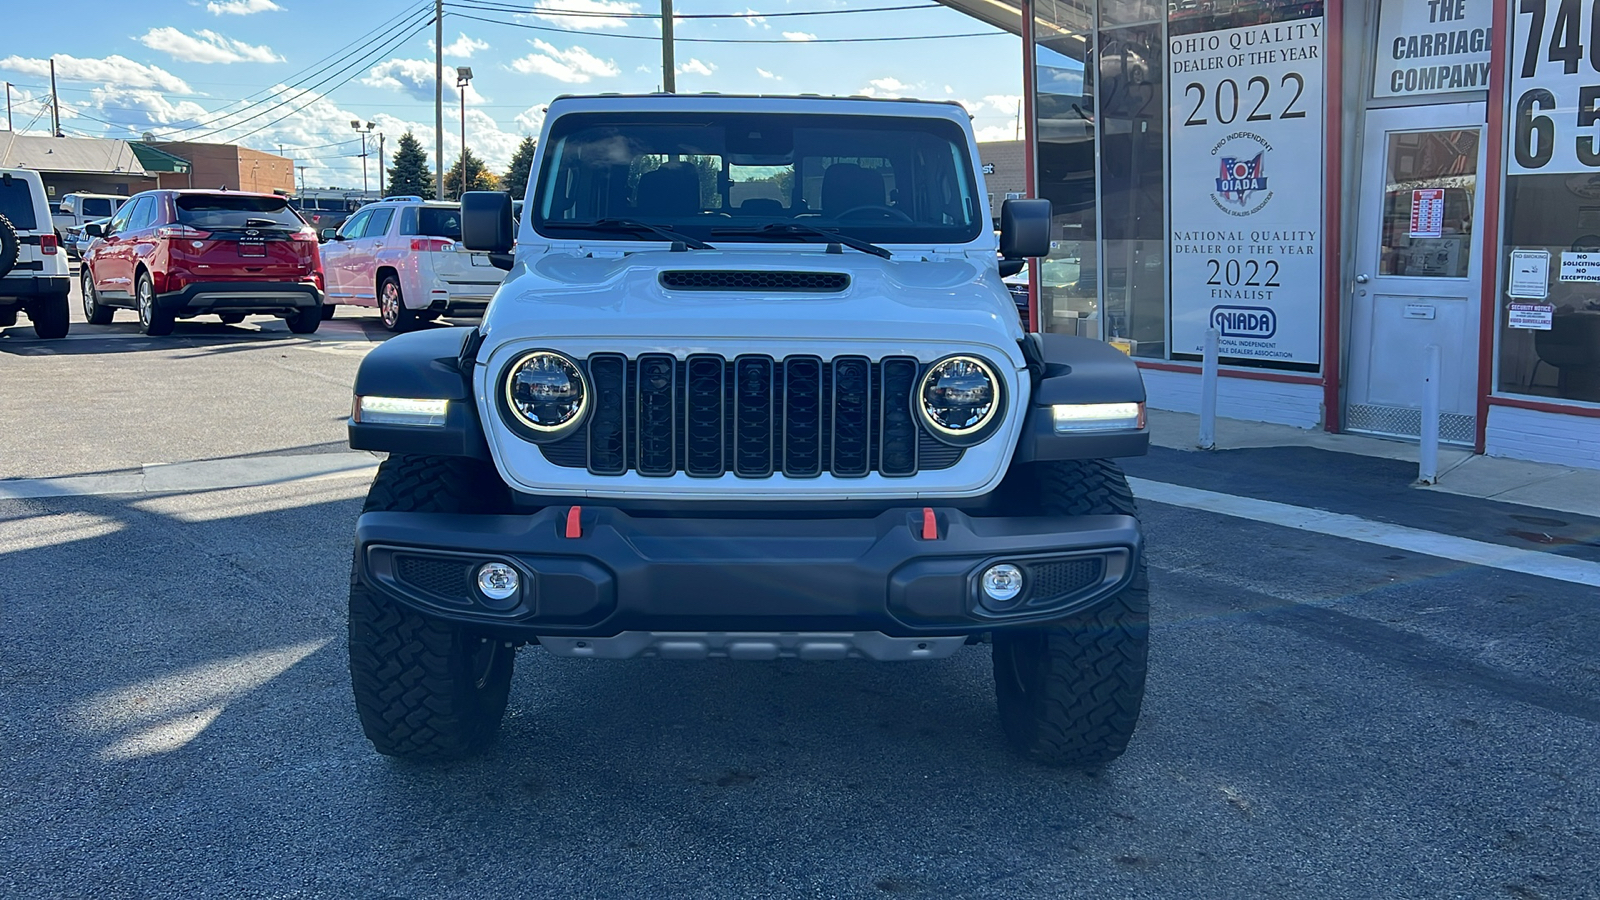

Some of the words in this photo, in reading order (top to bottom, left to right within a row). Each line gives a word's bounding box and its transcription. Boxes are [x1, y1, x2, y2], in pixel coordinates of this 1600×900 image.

[1428, 0, 1465, 23] THE
[1171, 36, 1220, 55] OHIO
[1229, 22, 1322, 49] QUALITY
[1519, 0, 1600, 78] 74
[1174, 56, 1224, 74] DEALER
[1227, 54, 1245, 68] OF
[1248, 50, 1276, 65] THE
[1279, 45, 1318, 62] YEAR
[1390, 63, 1491, 92] COMPANY
[1184, 72, 1306, 127] 2022
[1210, 138, 1227, 156] OHIO
[1226, 131, 1274, 153] INDEPENDENT
[1221, 178, 1259, 191] OIADA
[1174, 231, 1245, 241] NATIONAL
[1250, 230, 1317, 243] QUALITY
[1175, 244, 1222, 254] DEALER
[1227, 245, 1243, 254] OF
[1248, 245, 1274, 254] THE
[1279, 245, 1315, 255] YEAR
[1206, 258, 1281, 287] 2022
[1211, 289, 1273, 300] FINALIST
[1215, 312, 1270, 332] NIADA
[1230, 347, 1253, 355] DEALERS
[1255, 350, 1293, 358] ASSOCIATION
[1239, 340, 1276, 349] INDEPENDENT
